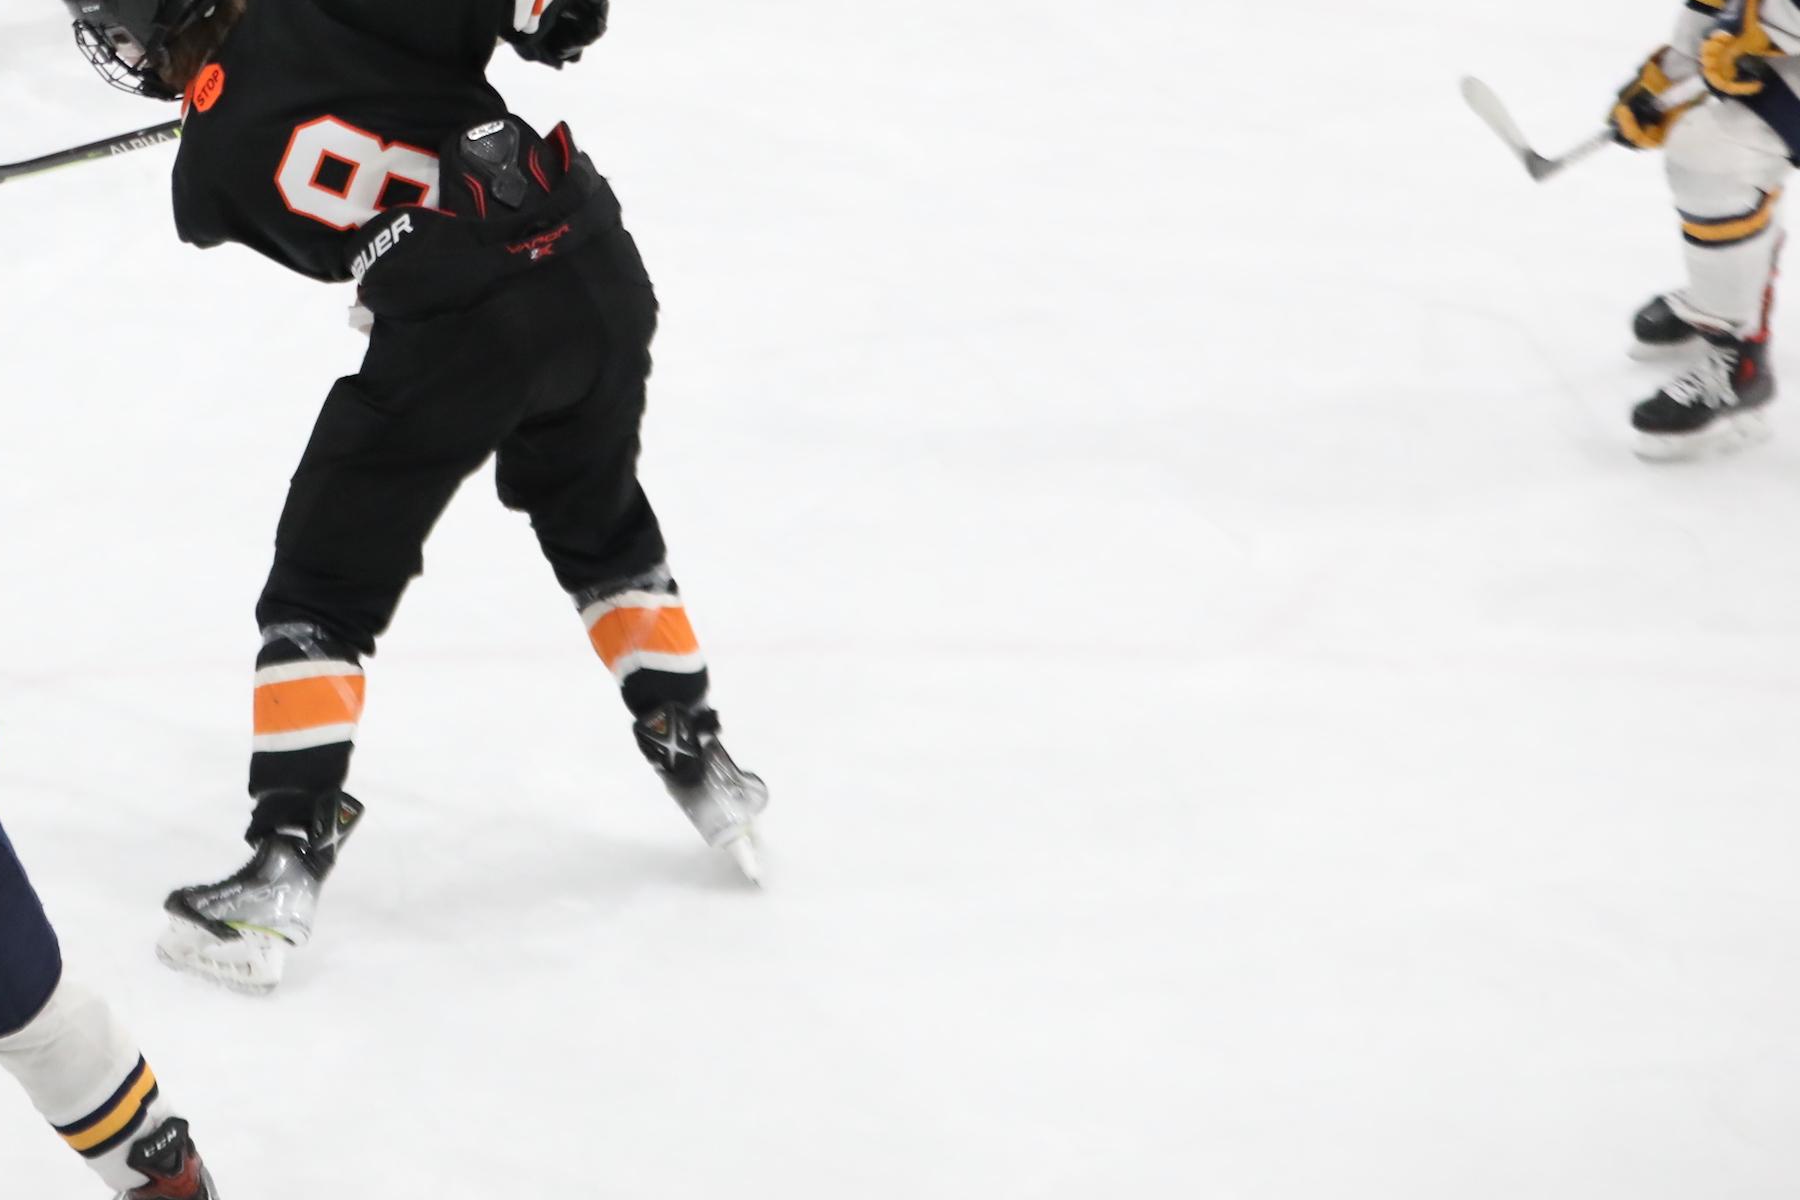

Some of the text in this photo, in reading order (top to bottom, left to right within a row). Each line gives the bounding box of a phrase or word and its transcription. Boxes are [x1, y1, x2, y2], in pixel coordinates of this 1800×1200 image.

[196, 68, 221, 107] STOP
[109, 132, 169, 156] ALPHA
[274, 114, 446, 231] 8
[350, 213, 415, 286] AUER
